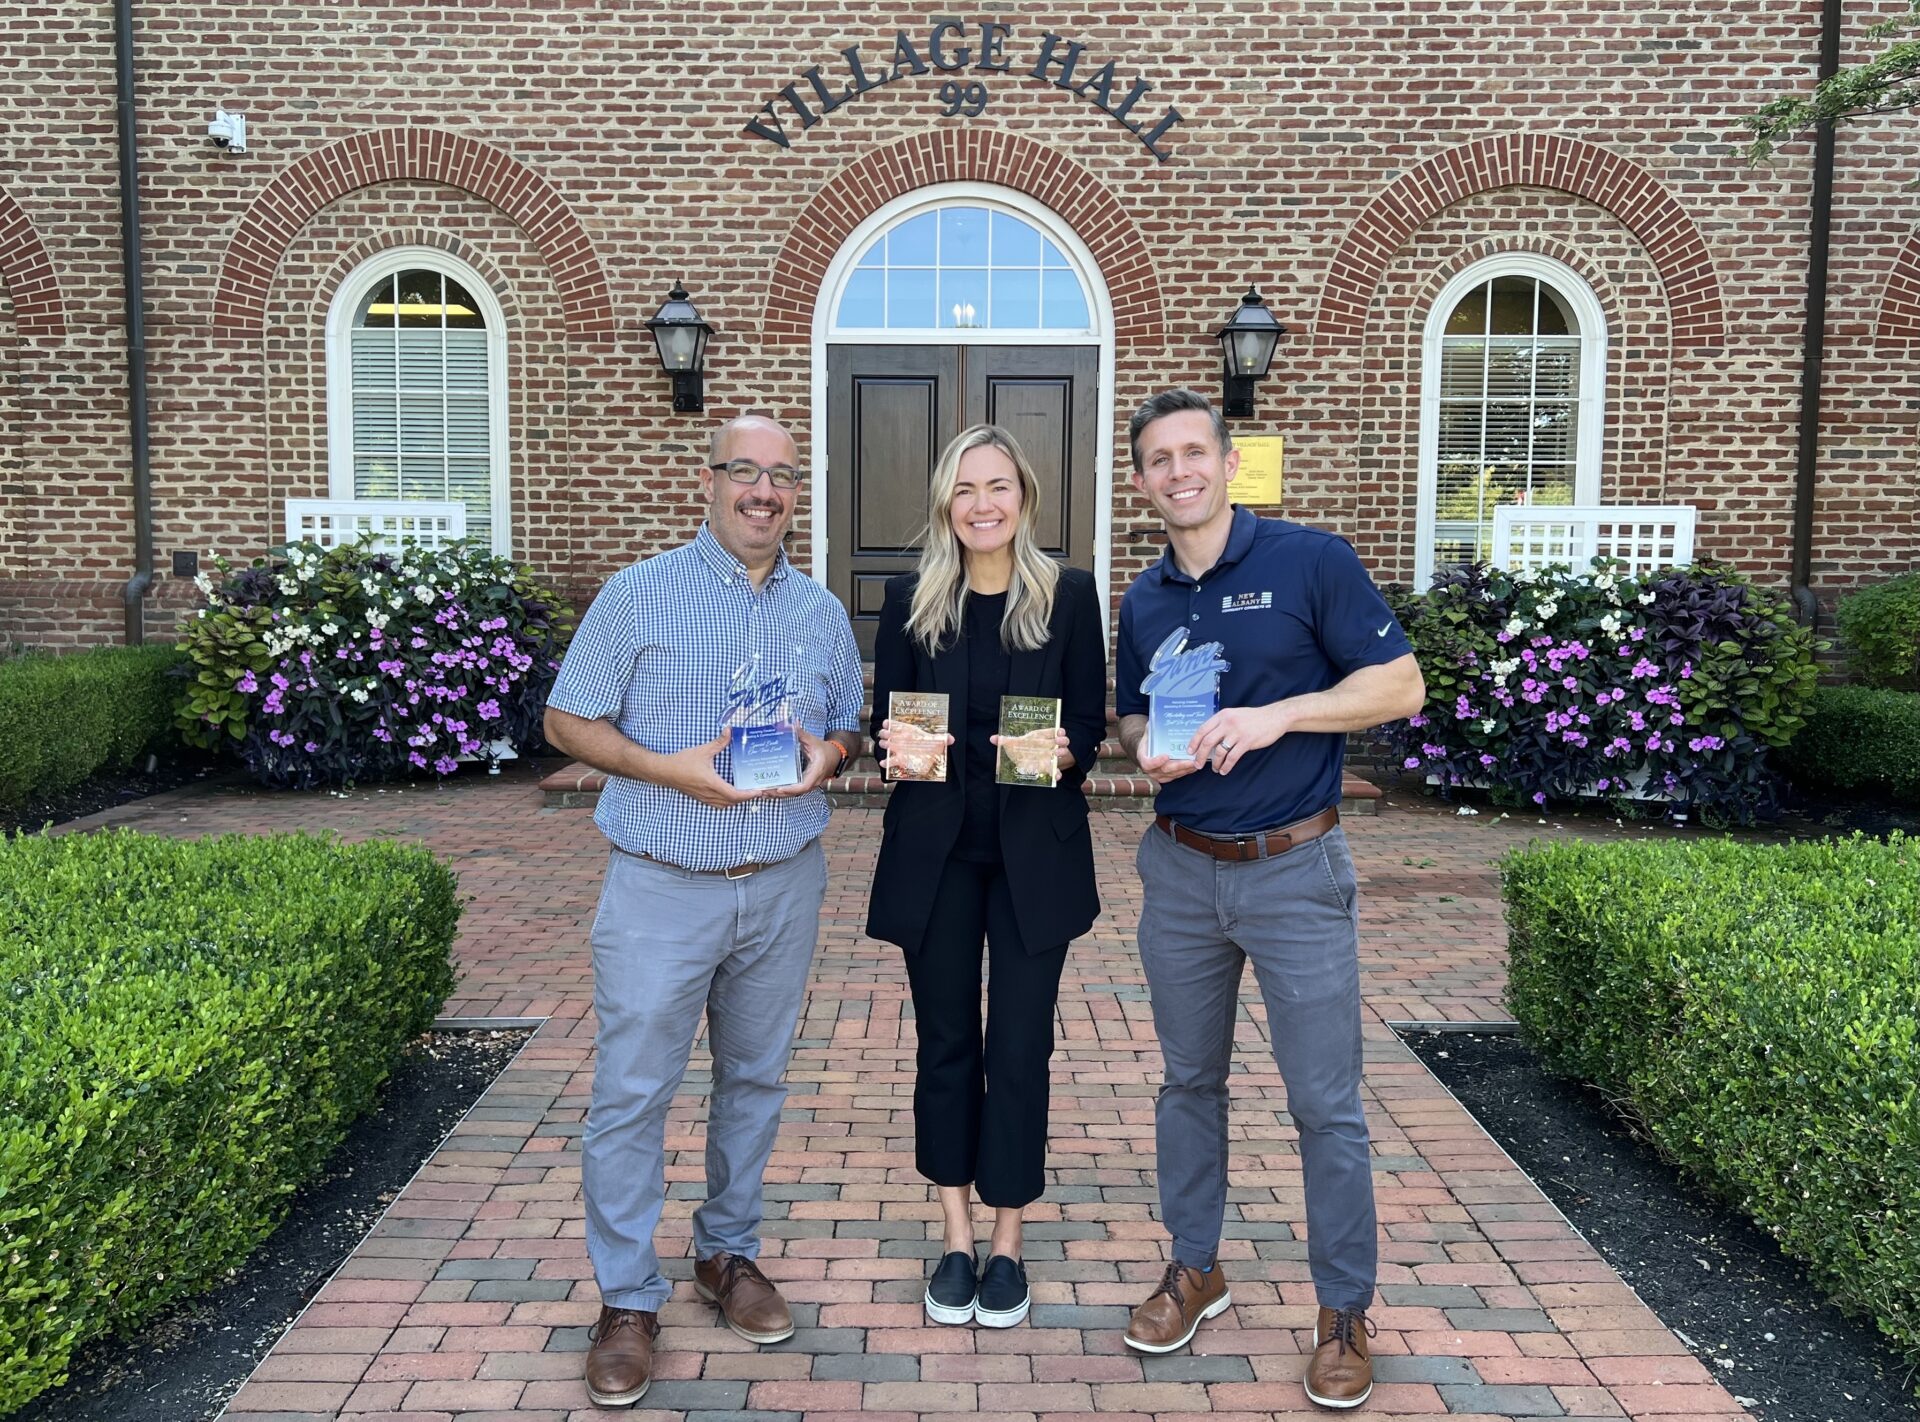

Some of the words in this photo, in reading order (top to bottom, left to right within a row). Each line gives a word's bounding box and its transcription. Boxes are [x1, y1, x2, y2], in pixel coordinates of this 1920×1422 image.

[743, 21, 1011, 148] VILLAGE
[1029, 31, 1185, 162] HALL
[938, 81, 988, 118] 99
[1238, 592, 1256, 600] NEW
[1232, 599, 1261, 607] ALBANY
[899, 700, 926, 708] AWARD
[1011, 704, 1039, 712] AWARD
[896, 707, 941, 715] EXCELLENCE
[1008, 711, 1054, 721] EXCELLENCE
